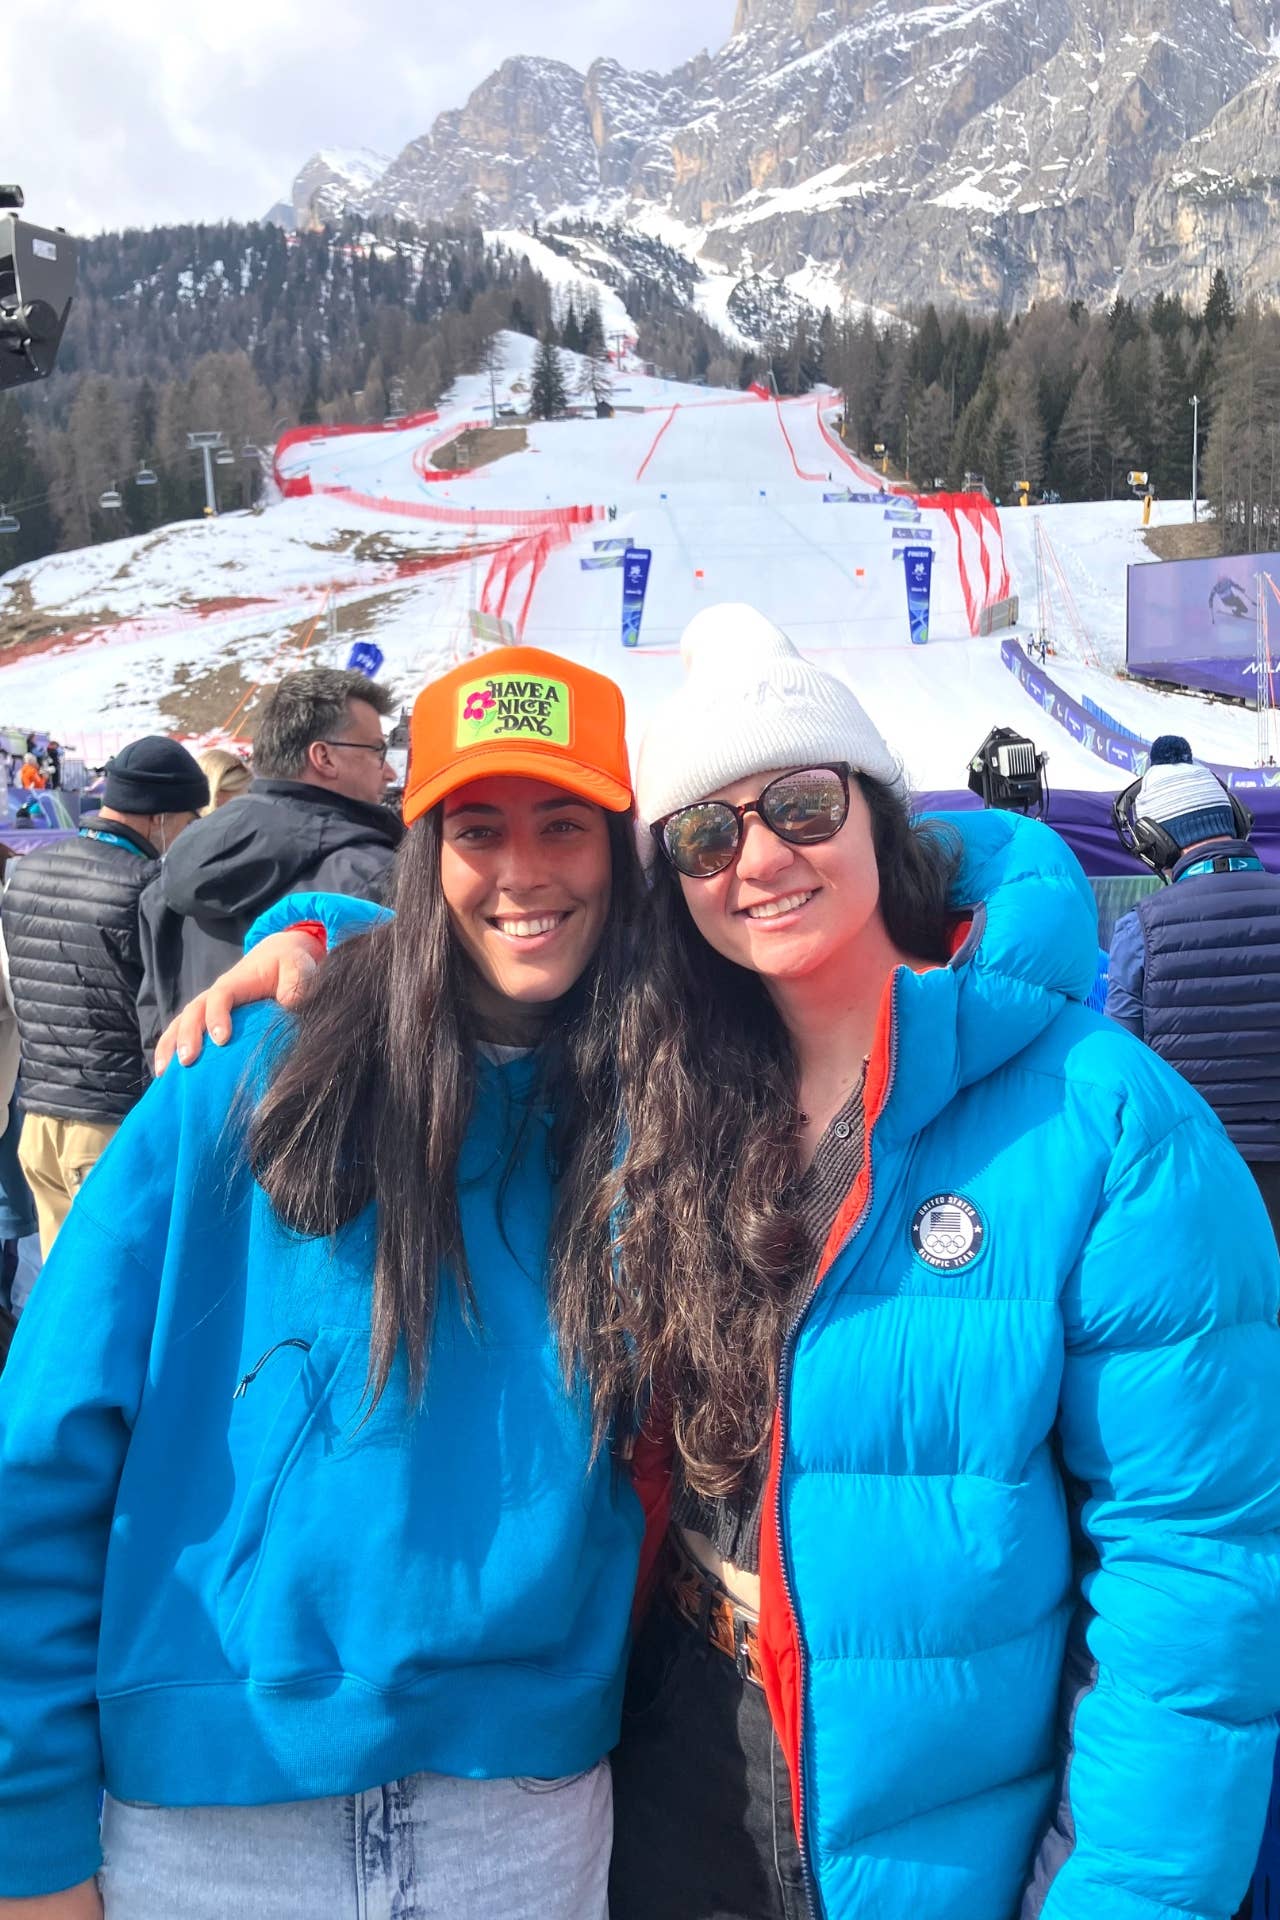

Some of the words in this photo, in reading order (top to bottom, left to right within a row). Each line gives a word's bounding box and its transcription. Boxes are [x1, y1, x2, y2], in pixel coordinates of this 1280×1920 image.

[485, 680, 544, 699] HAVE
[544, 686, 560, 702] A
[498, 698, 552, 717] NICE
[494, 714, 553, 737] DAY
[918, 1196, 945, 1216] UNITED
[947, 1196, 976, 1217] STATES
[918, 1248, 950, 1267] OLYMPIC
[954, 1250, 976, 1266] TEAM
